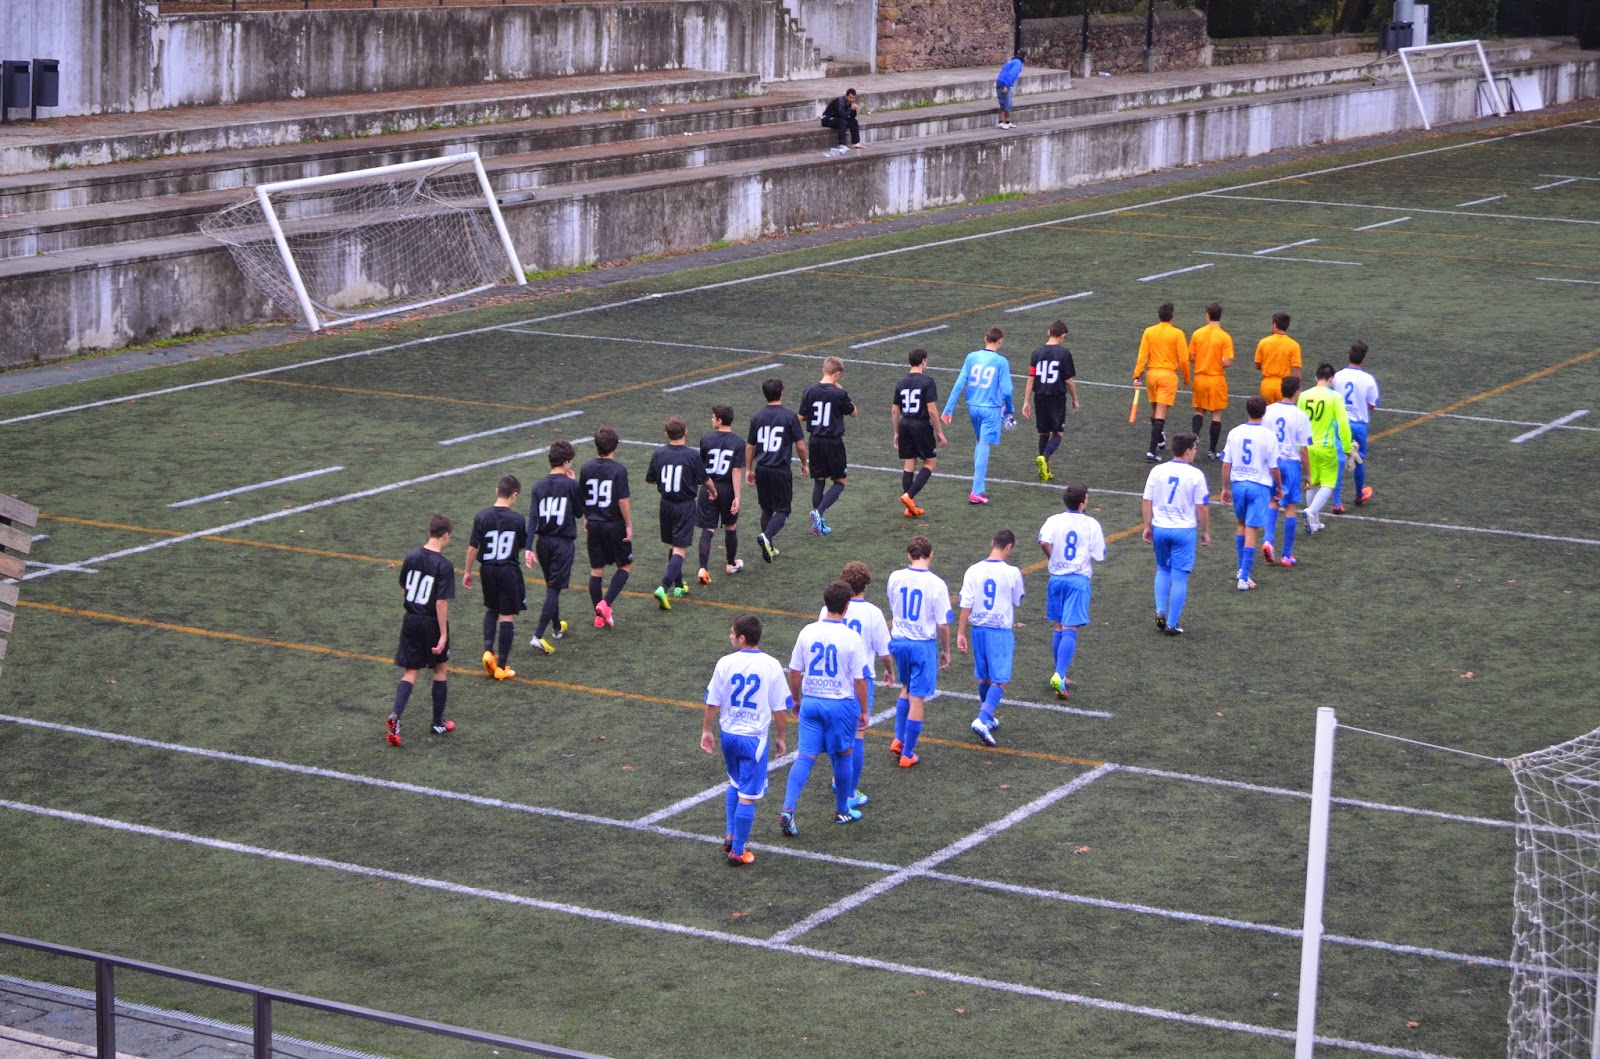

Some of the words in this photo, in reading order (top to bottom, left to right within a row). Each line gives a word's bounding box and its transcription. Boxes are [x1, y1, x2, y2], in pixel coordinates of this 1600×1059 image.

[968, 364, 996, 389] 99
[1036, 360, 1060, 384] 45
[900, 388, 921, 414] 35
[1345, 381, 1354, 405] 2
[811, 401, 832, 427] 31
[1305, 399, 1325, 422] 50
[757, 425, 785, 453] 46
[1276, 417, 1286, 443] 3
[705, 448, 734, 476] 36
[1242, 438, 1252, 465] 5
[585, 478, 613, 508] 39
[661, 464, 683, 493] 41
[1167, 475, 1180, 505] 7
[539, 496, 568, 526] 44
[483, 530, 516, 561] 38
[1064, 530, 1078, 562] 8
[405, 569, 435, 606] 40
[983, 578, 997, 611] 9
[900, 586, 923, 622] 10
[808, 641, 838, 678] 20
[730, 672, 761, 710] 22
